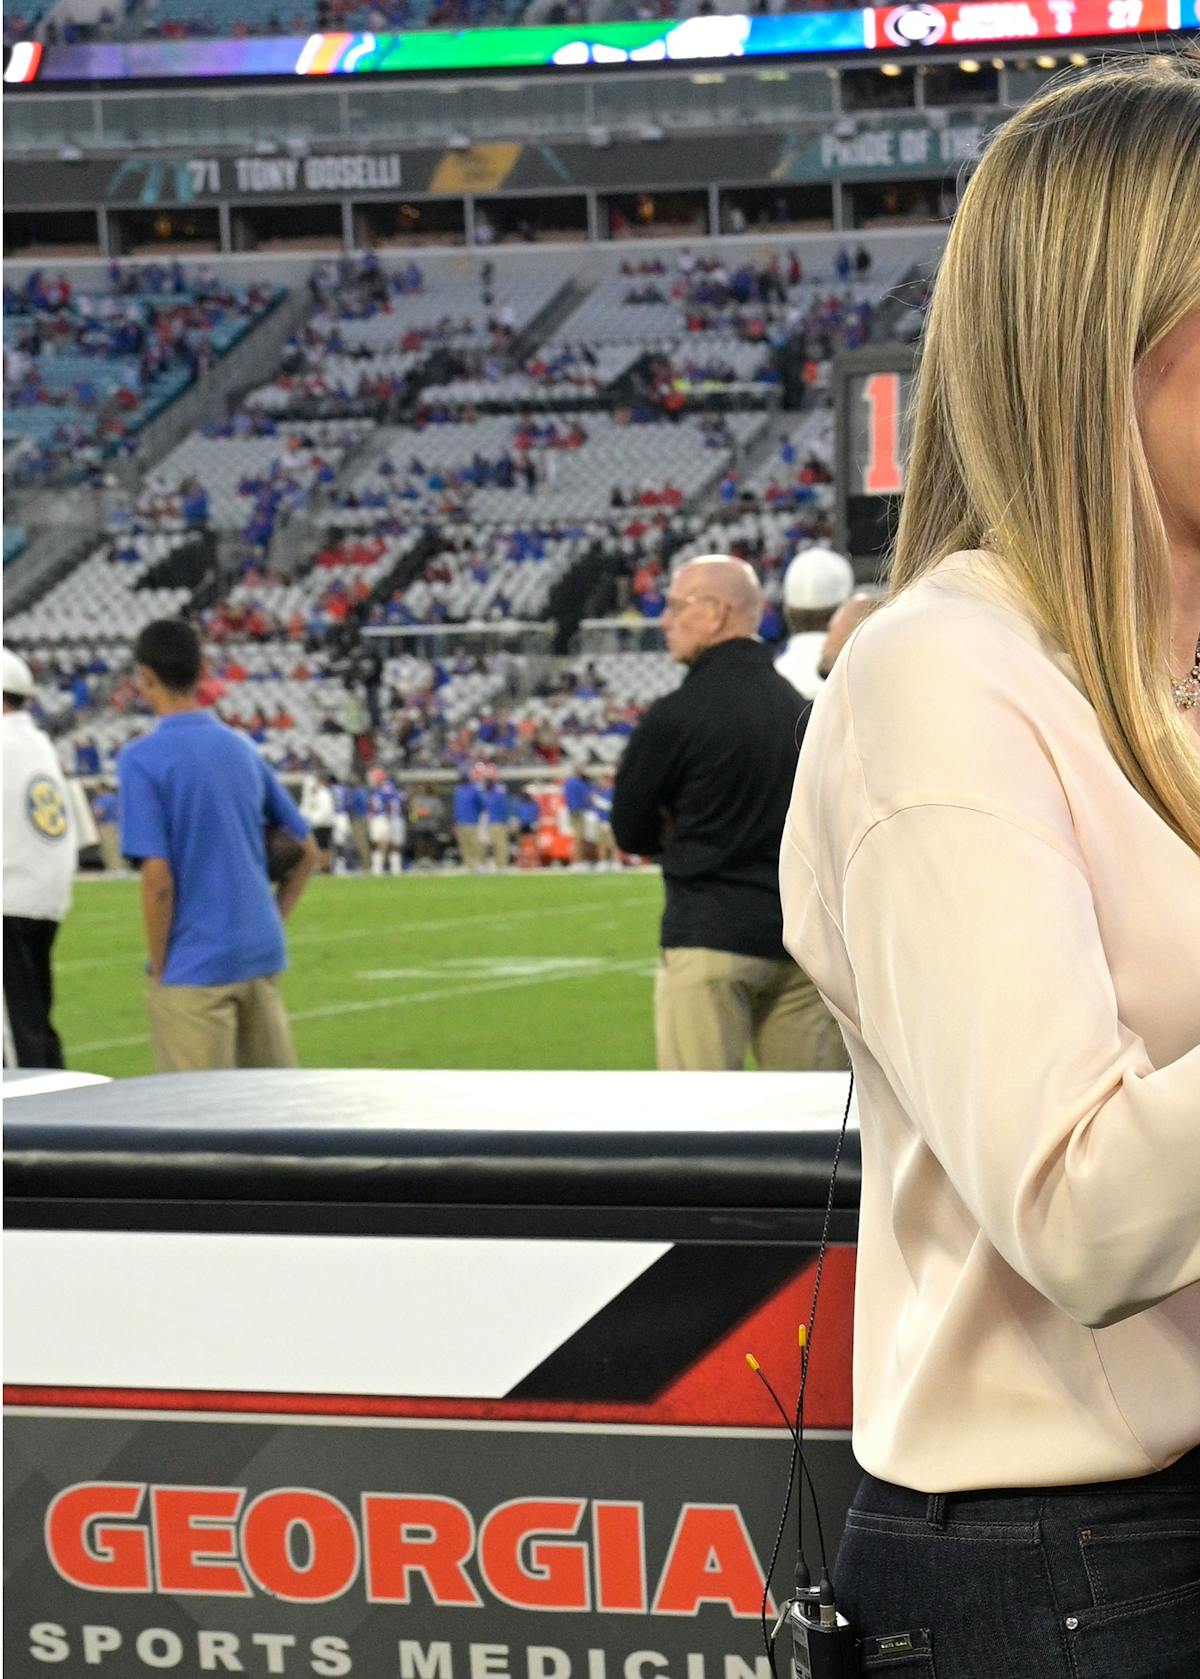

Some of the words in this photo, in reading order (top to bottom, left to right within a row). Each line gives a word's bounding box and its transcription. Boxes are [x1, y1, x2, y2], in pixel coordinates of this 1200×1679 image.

[187, 158, 220, 193] 71
[234, 157, 299, 191] TONY
[863, 373, 903, 494] 1
[44, 1480, 780, 1620] GEORGIA
[28, 1621, 353, 1677] SPORTS
[399, 1639, 797, 1679] MEDICIN
